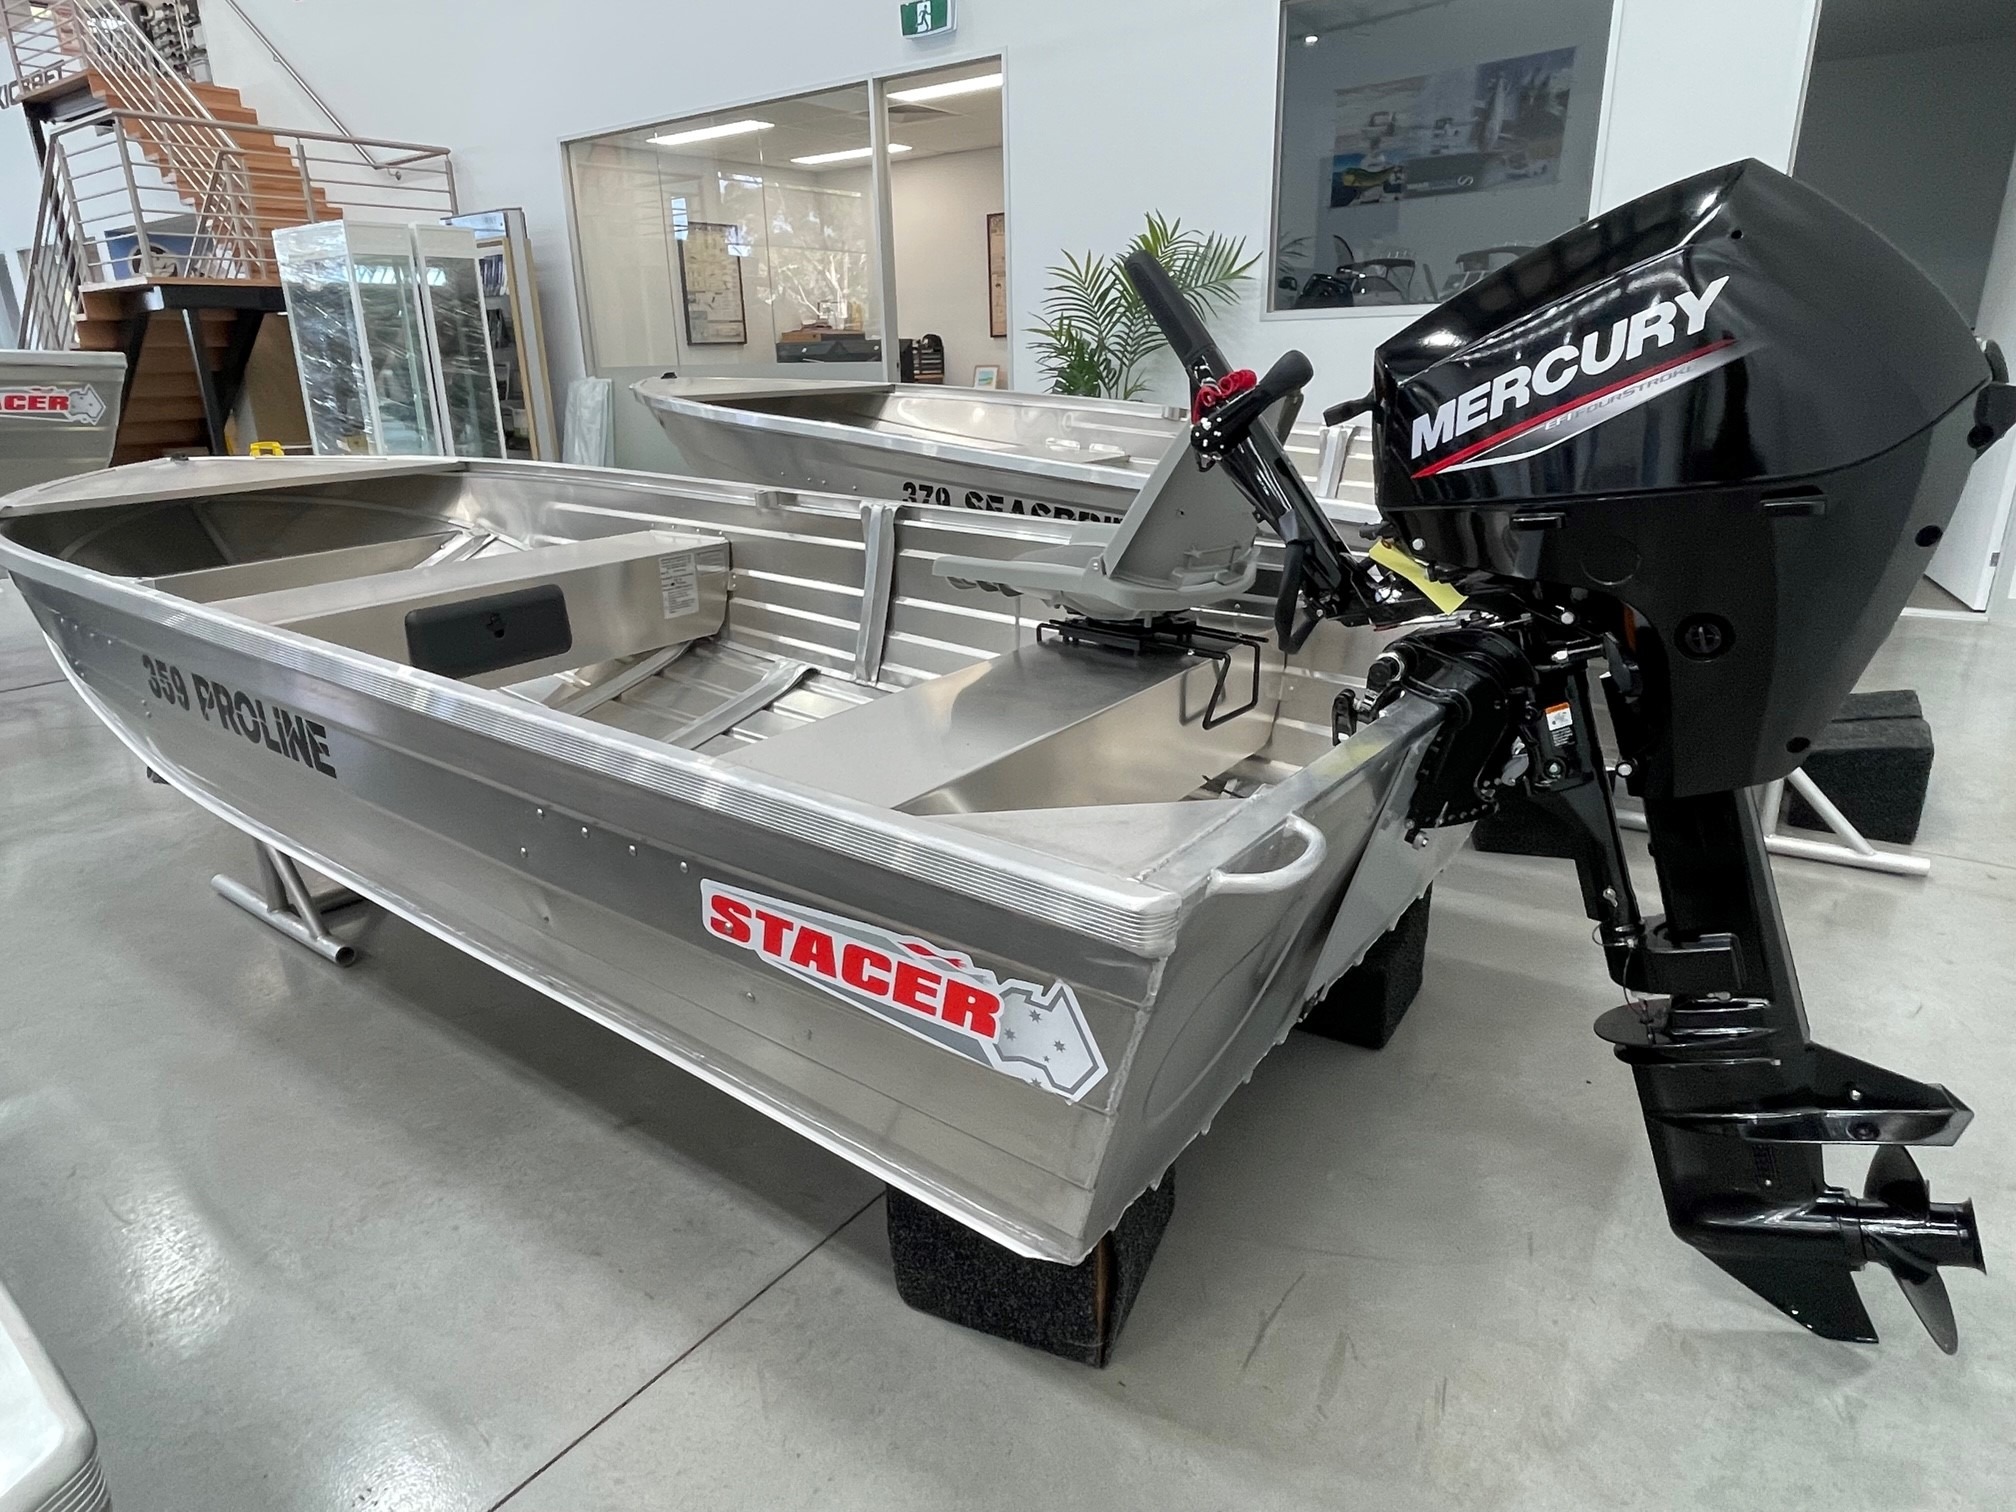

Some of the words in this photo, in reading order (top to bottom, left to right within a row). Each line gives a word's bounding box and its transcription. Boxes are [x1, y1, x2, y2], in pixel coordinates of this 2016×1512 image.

[0, 395, 69, 411] CER
[1411, 275, 1730, 460] MERCURY
[142, 654, 190, 711] 359
[191, 672, 337, 779] PROLINE
[710, 894, 1001, 1039] STACER
